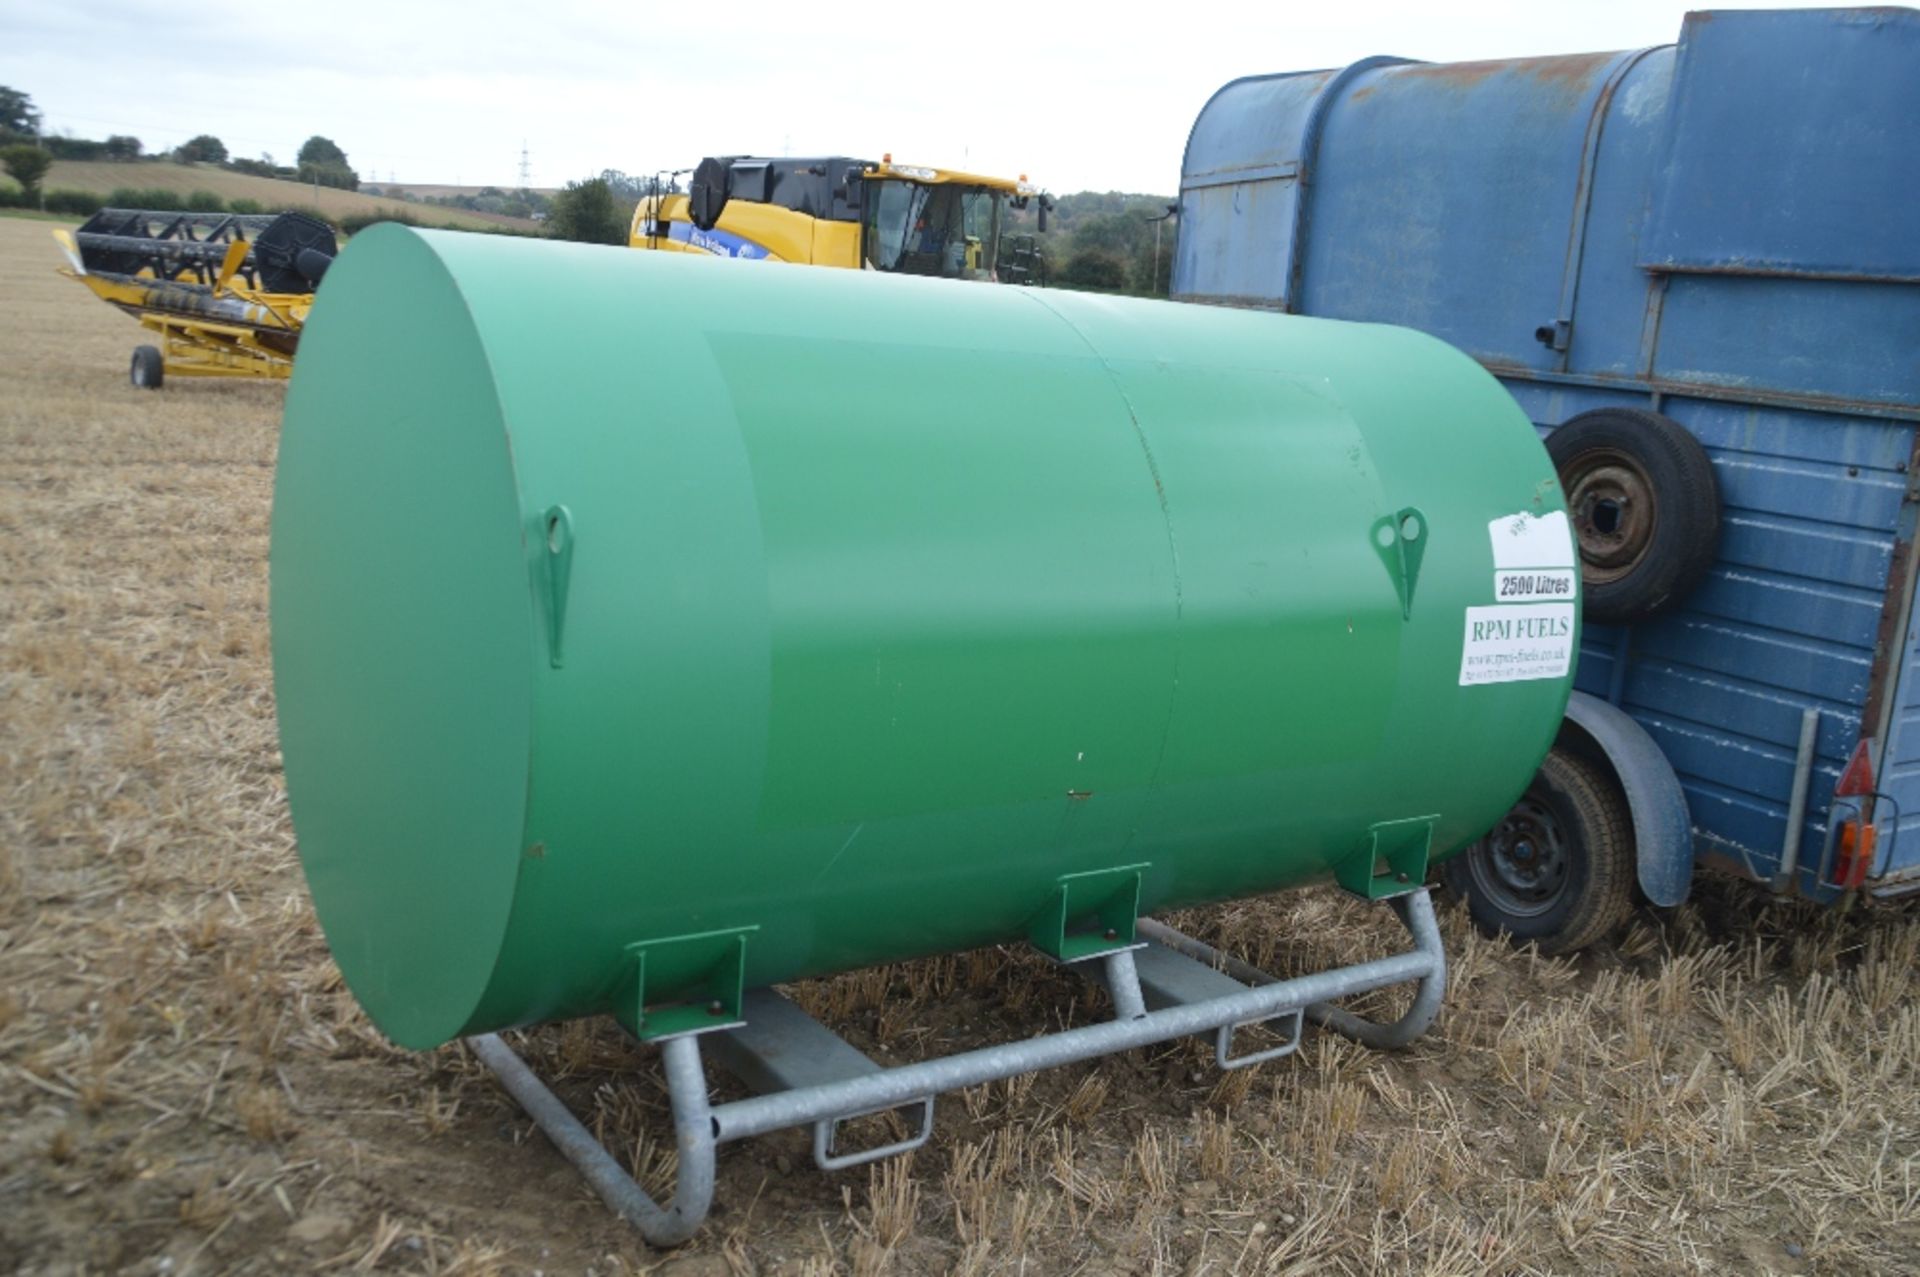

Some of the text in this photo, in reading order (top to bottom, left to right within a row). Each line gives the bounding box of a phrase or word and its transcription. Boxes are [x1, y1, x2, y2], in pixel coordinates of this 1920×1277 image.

[1501, 575, 1570, 596] 2500 Litres
[1472, 616, 1569, 642] RPM FUELS
